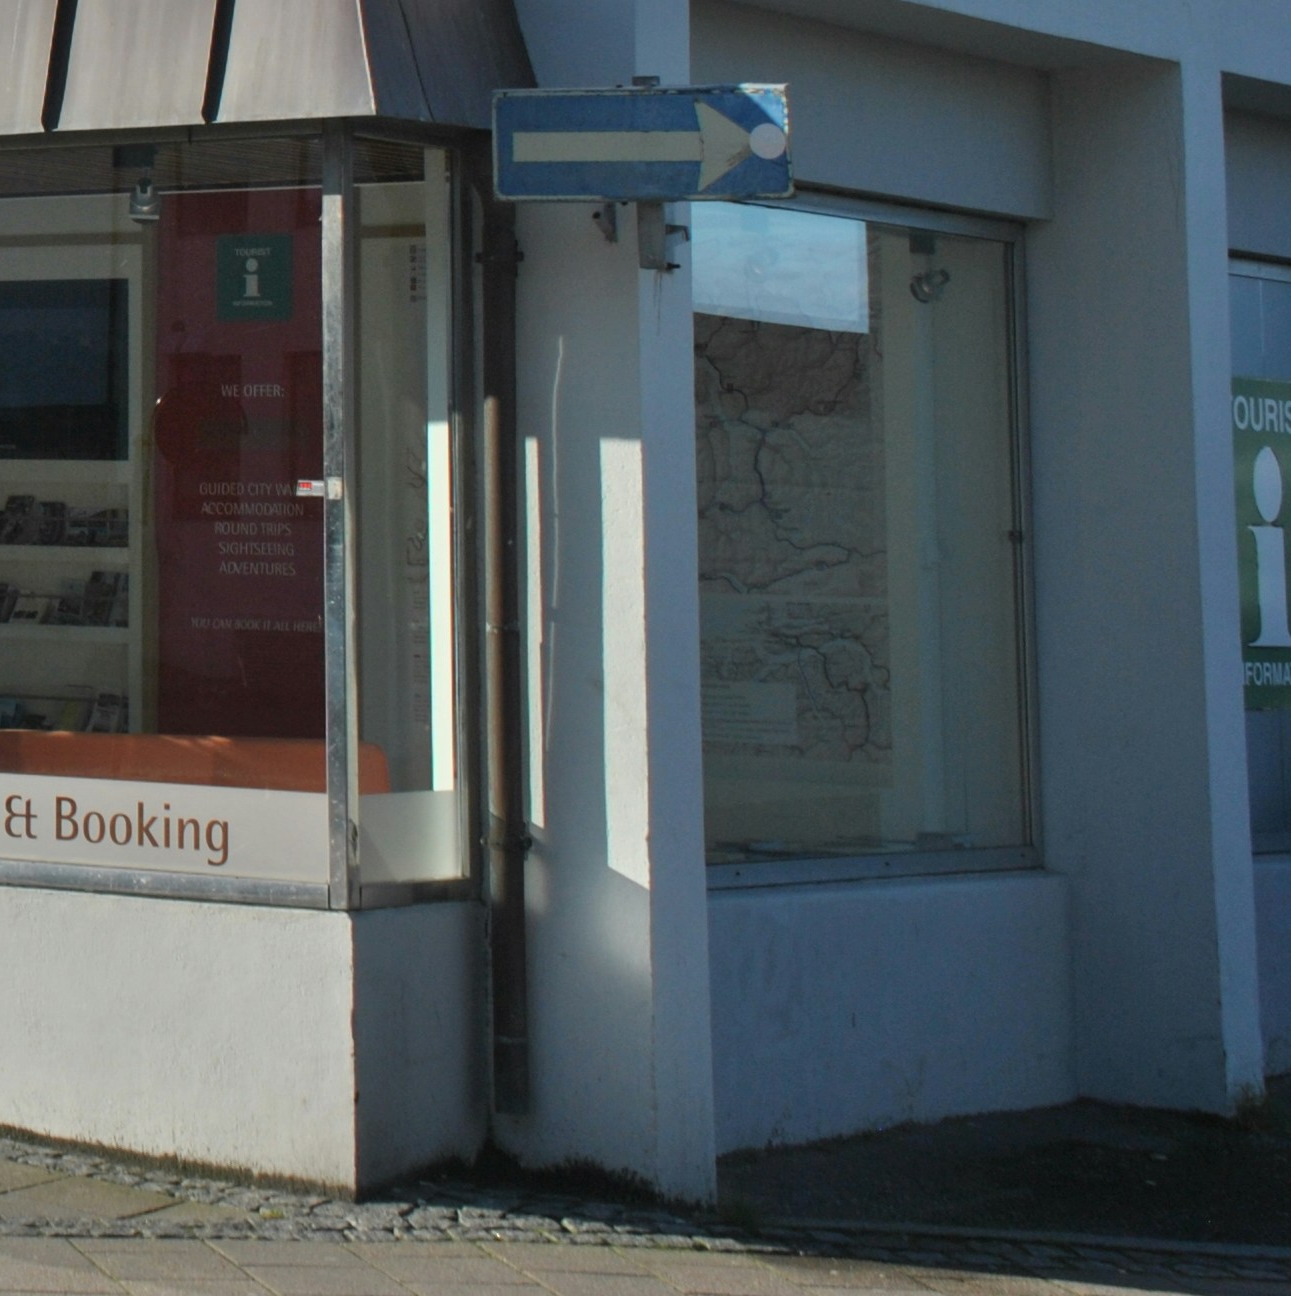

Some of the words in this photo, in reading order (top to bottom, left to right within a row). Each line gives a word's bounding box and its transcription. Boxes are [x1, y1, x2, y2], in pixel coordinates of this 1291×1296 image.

[235, 248, 272, 257] TOURIST
[221, 384, 239, 397] WE
[243, 384, 285, 397] OFFER:
[1233, 395, 1291, 434] OURIS
[199, 482, 244, 496] GUIDED
[247, 482, 272, 496] CITY
[201, 502, 304, 517] ACCOMMODATION
[215, 522, 257, 536] ROUND
[261, 522, 291, 536] TRIPS
[218, 542, 295, 556] SIGHTSEEING
[219, 561, 296, 576] ADVENTURES
[191, 616, 210, 629] YOU
[213, 617, 231, 629] CAN
[1243, 661, 1291, 687] FORMA
[54, 796, 231, 867] Booking
